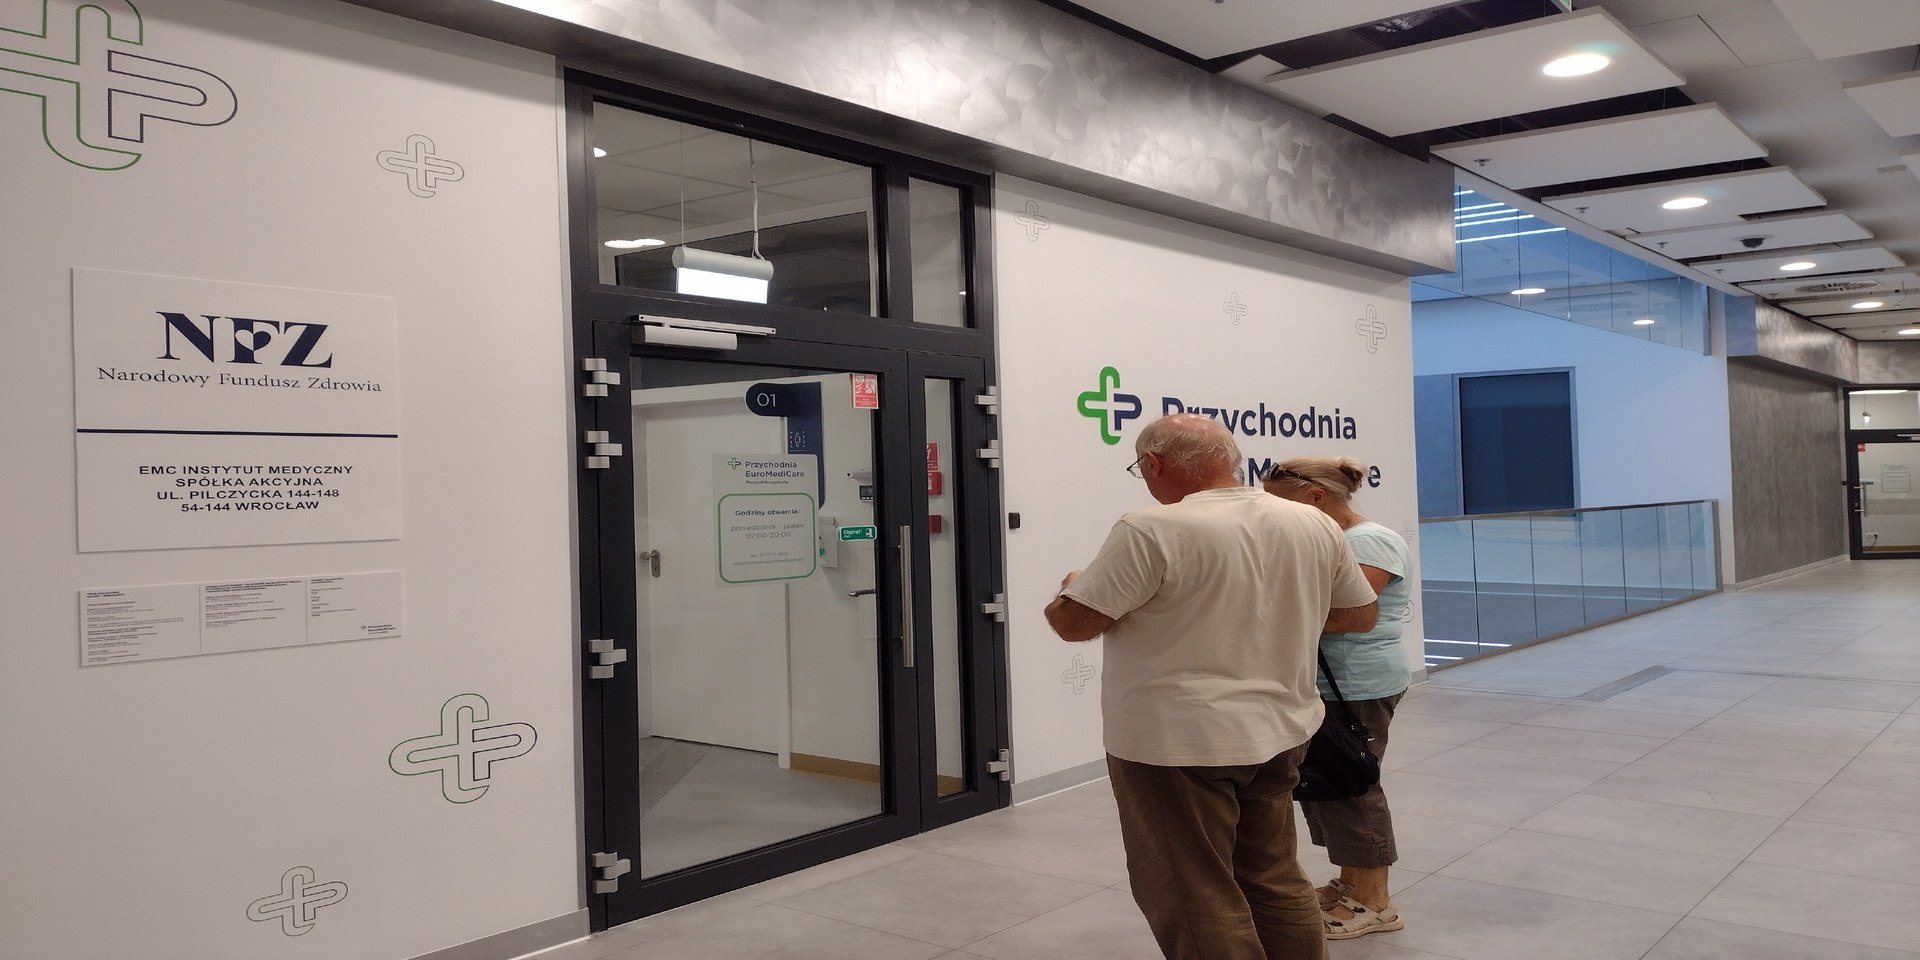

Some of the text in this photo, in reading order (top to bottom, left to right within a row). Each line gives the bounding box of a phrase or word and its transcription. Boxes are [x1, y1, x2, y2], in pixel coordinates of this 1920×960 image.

[156, 311, 332, 368] NFZ
[97, 367, 382, 392] Narodowy Fundusz Zdrowia
[1162, 396, 1357, 440] Pychodnia
[139, 465, 353, 475] EMC INSTYTUT MEDYCZNY
[745, 461, 797, 470] Przychodnia
[745, 470, 805, 478] EuroMediCare
[175, 476, 324, 487] SPÓŁKA AKCYJNA
[156, 489, 340, 500] UL. PILCZYCKA 144-148
[181, 501, 320, 512] 54-144 WROCŁAW
[735, 509, 766, 517] Godziny
